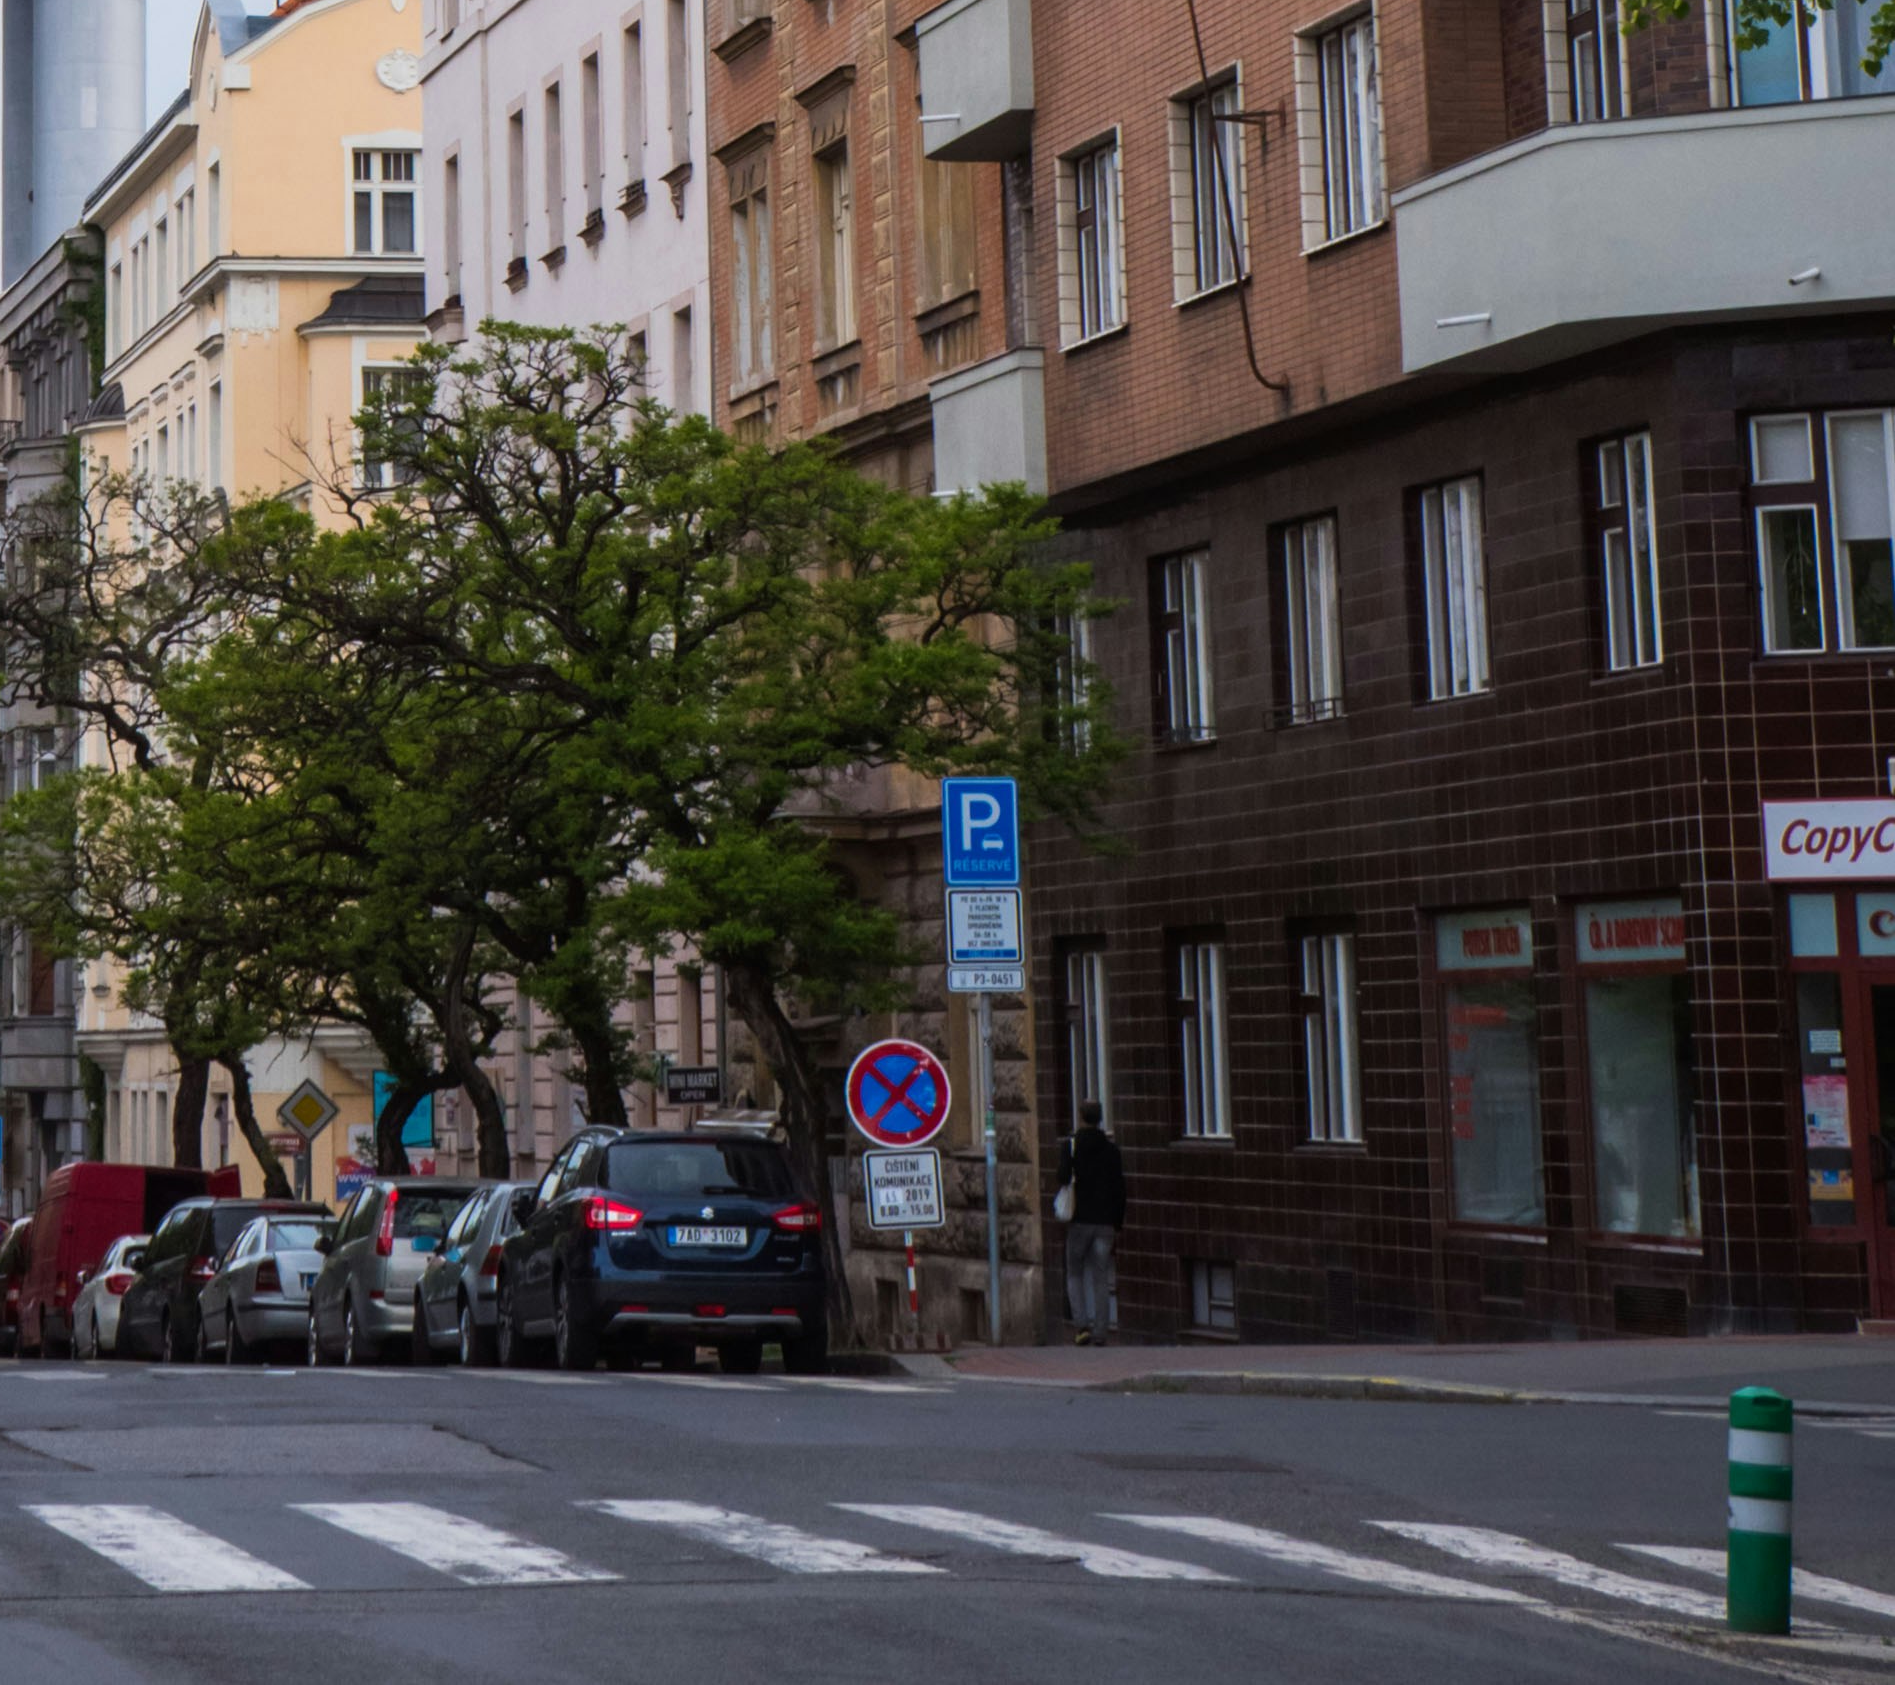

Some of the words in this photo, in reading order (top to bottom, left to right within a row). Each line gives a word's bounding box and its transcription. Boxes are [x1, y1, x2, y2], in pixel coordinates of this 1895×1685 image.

[961, 793, 1001, 850] P
[874, 1175, 932, 1188] KOMUNIKACE
[905, 1188, 931, 1202] 2019
[711, 1229, 741, 1243] 3102
